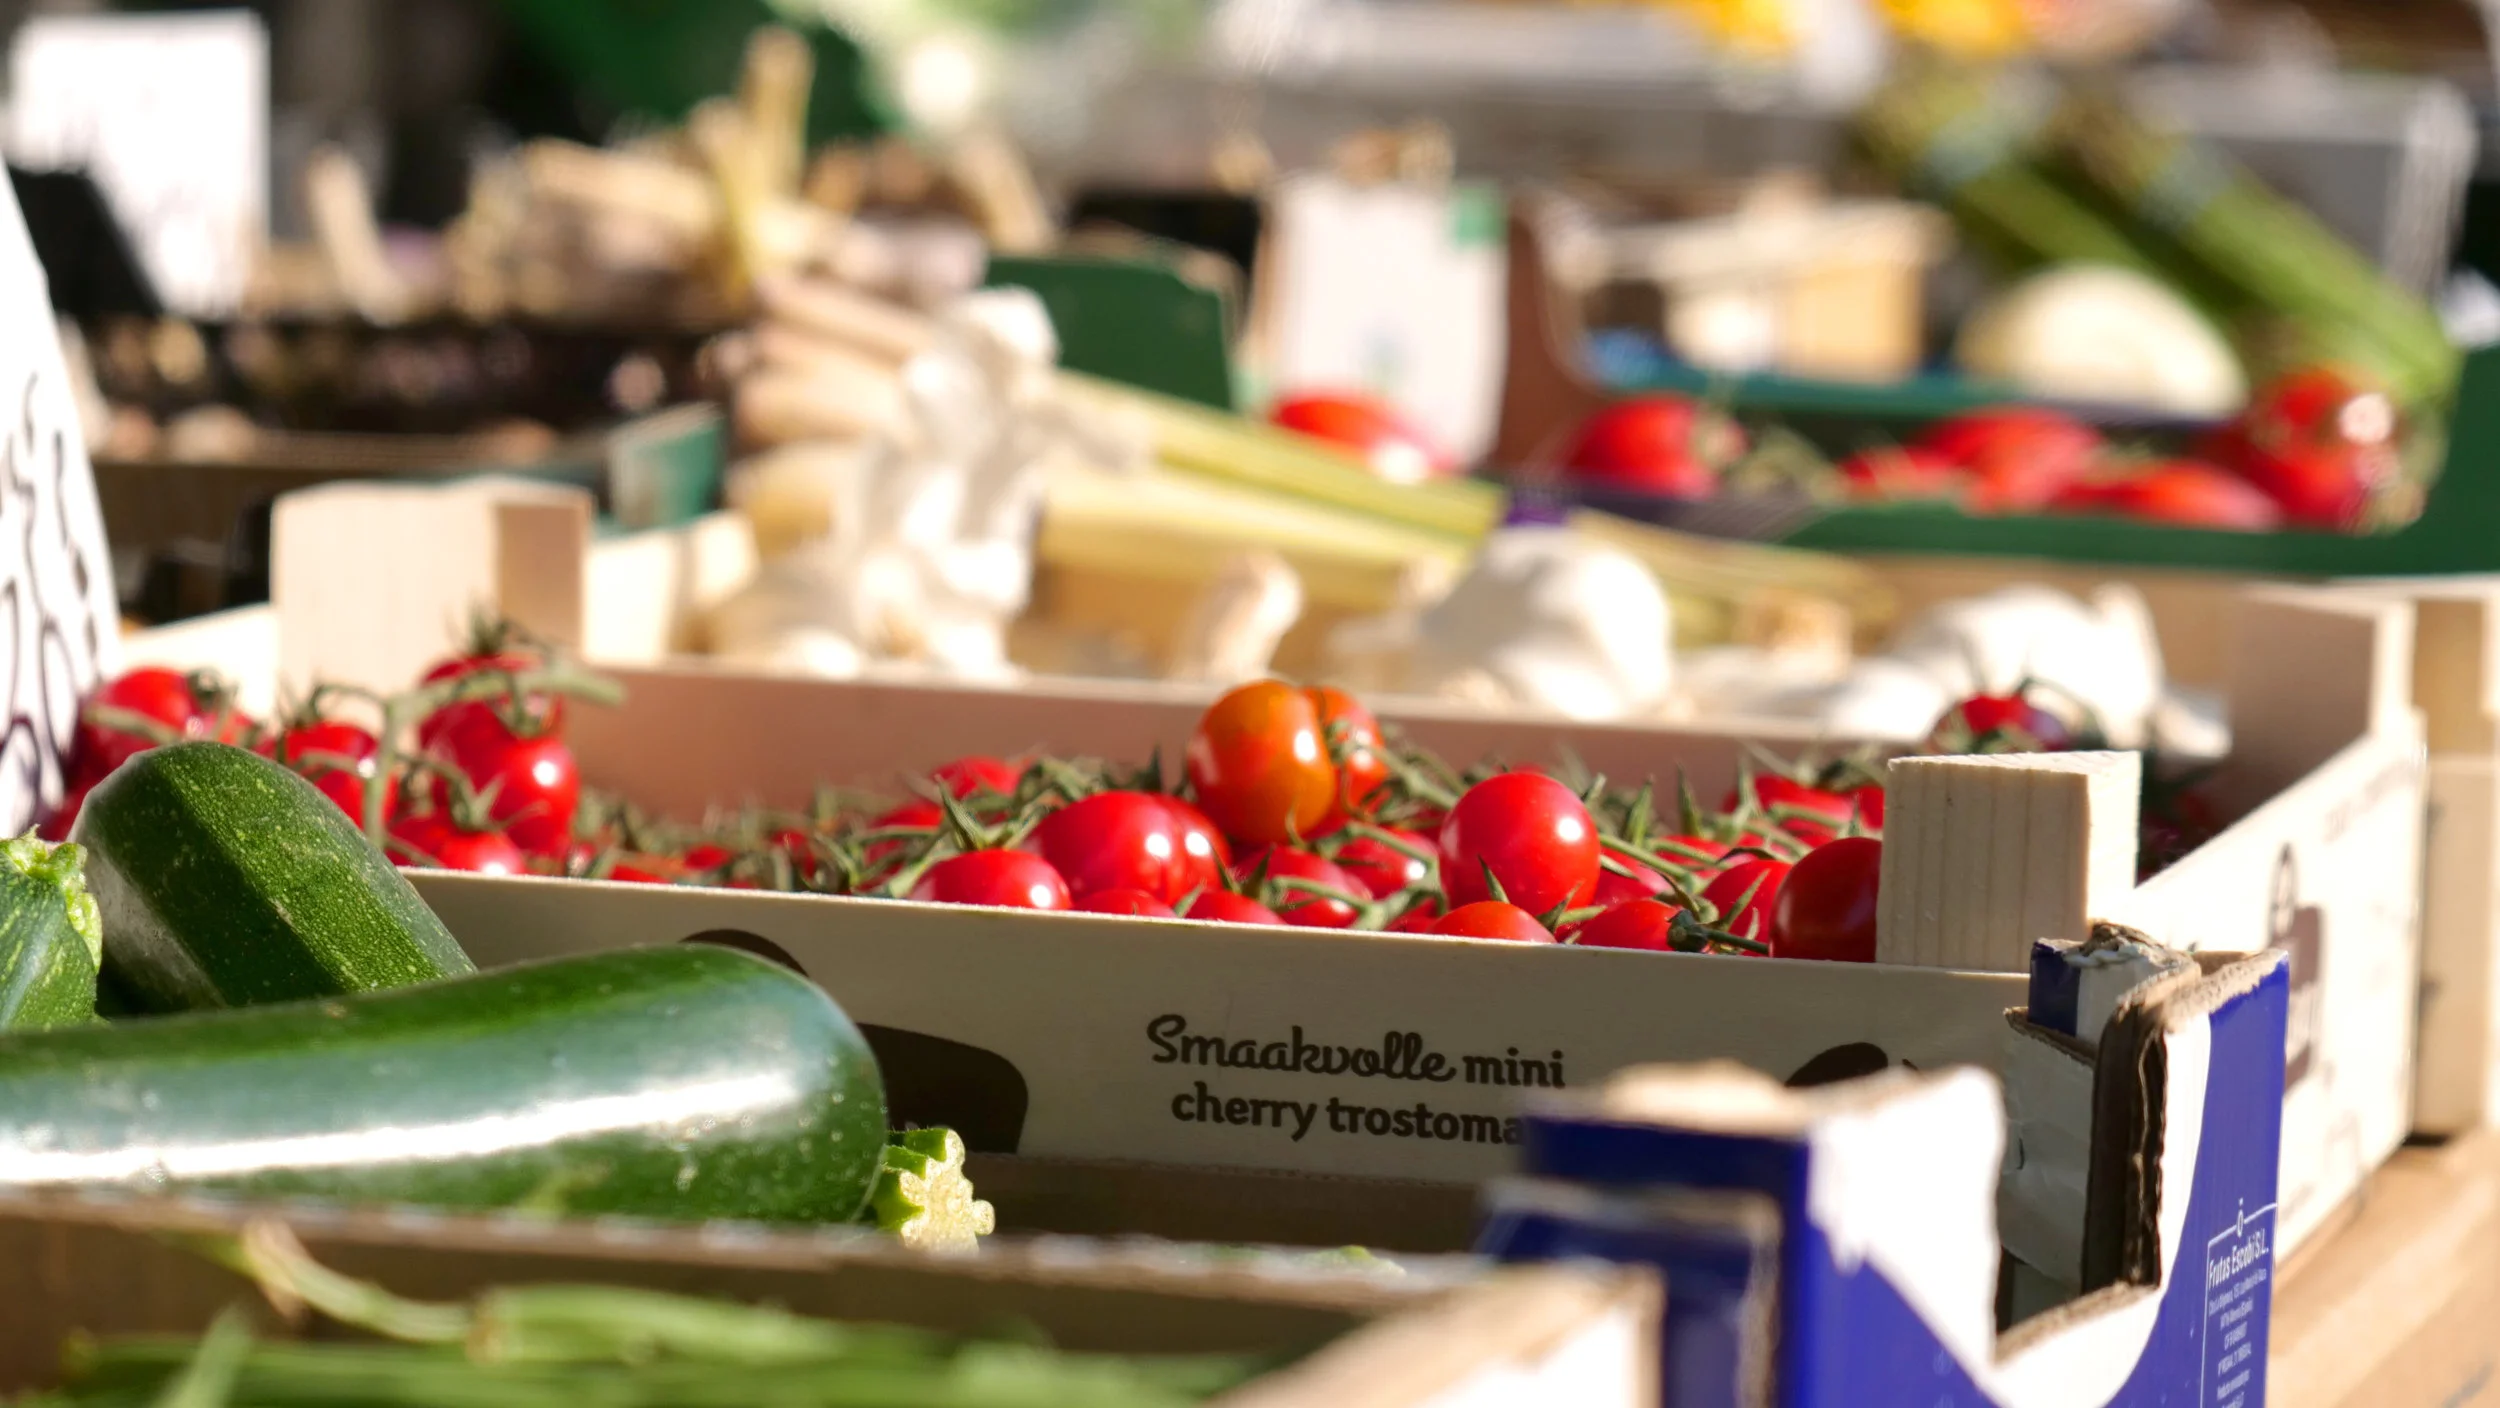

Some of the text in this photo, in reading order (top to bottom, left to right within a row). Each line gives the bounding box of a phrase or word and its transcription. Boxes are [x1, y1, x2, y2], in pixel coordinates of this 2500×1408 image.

[1146, 1013, 1567, 1089] Smaakvolle mini
[1170, 1081, 1526, 1145] cherry trostoma
[2208, 1257, 2231, 1291] Frutas
